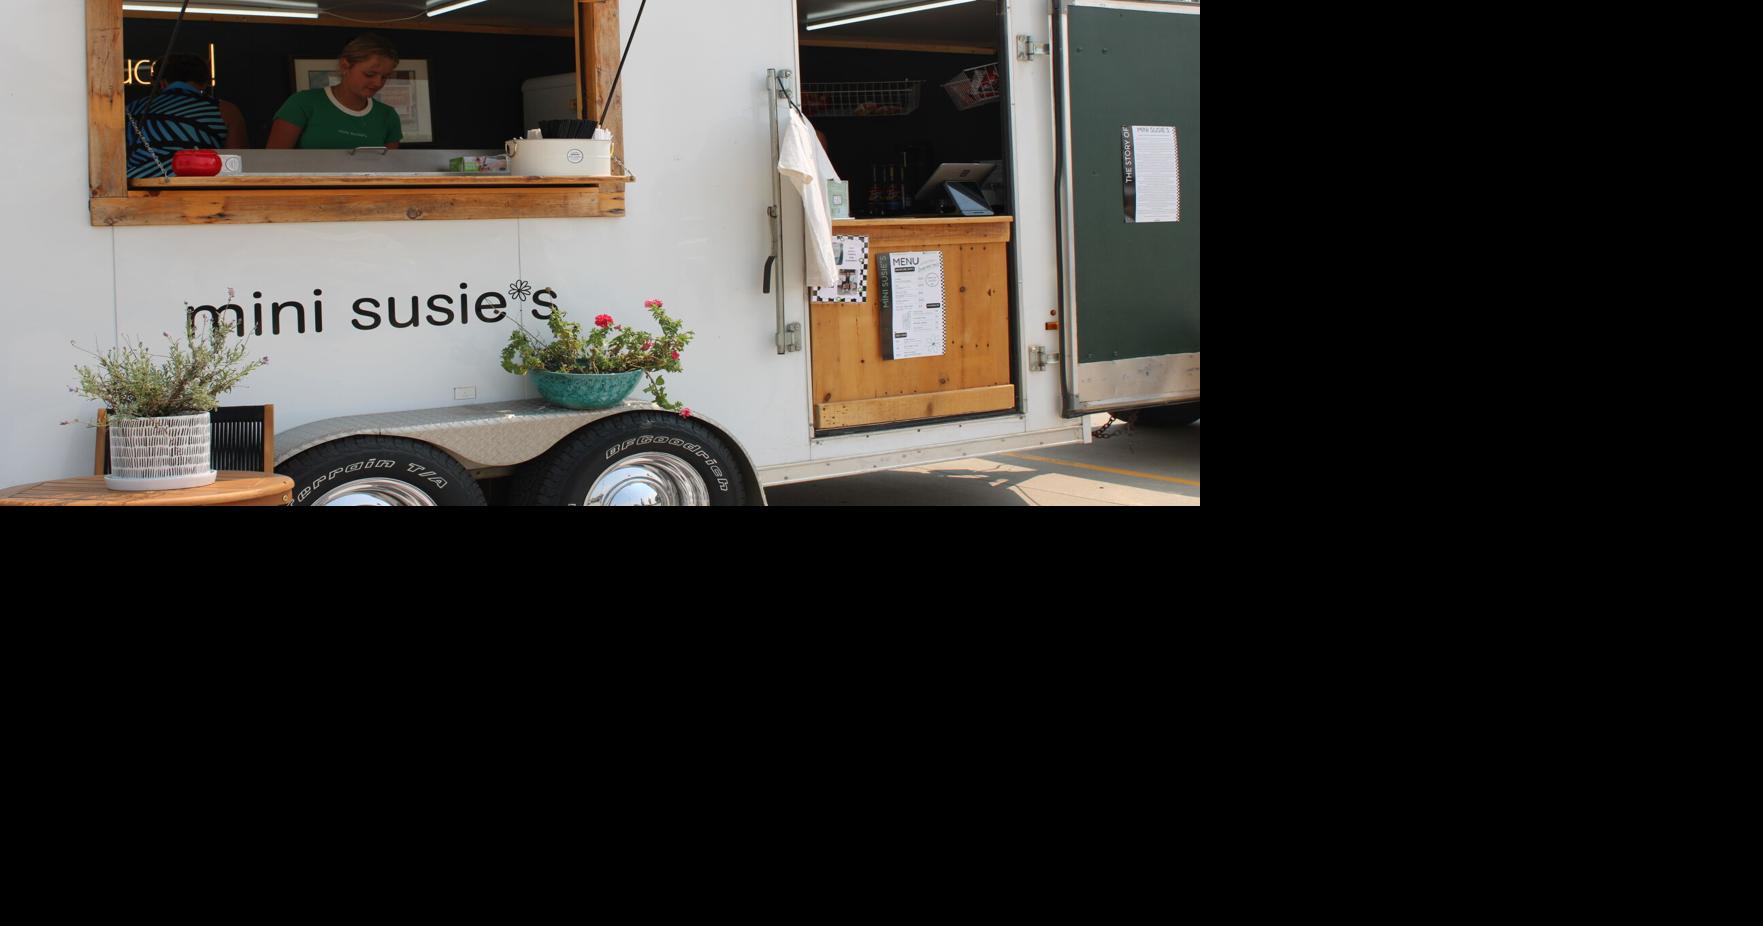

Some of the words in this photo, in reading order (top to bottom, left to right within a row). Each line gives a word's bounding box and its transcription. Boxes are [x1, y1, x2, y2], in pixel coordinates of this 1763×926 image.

[1122, 126, 1130, 138] OF
[1124, 140, 1132, 166] STORY
[1125, 167, 1133, 183] THE
[879, 255, 889, 287] SUSIE'S
[892, 257, 920, 266] MENU
[881, 289, 889, 308] MINI
[186, 288, 323, 338] mini
[605, 435, 729, 492] BFGoodrich
[286, 458, 395, 506] errain
[407, 462, 448, 489] T/A
